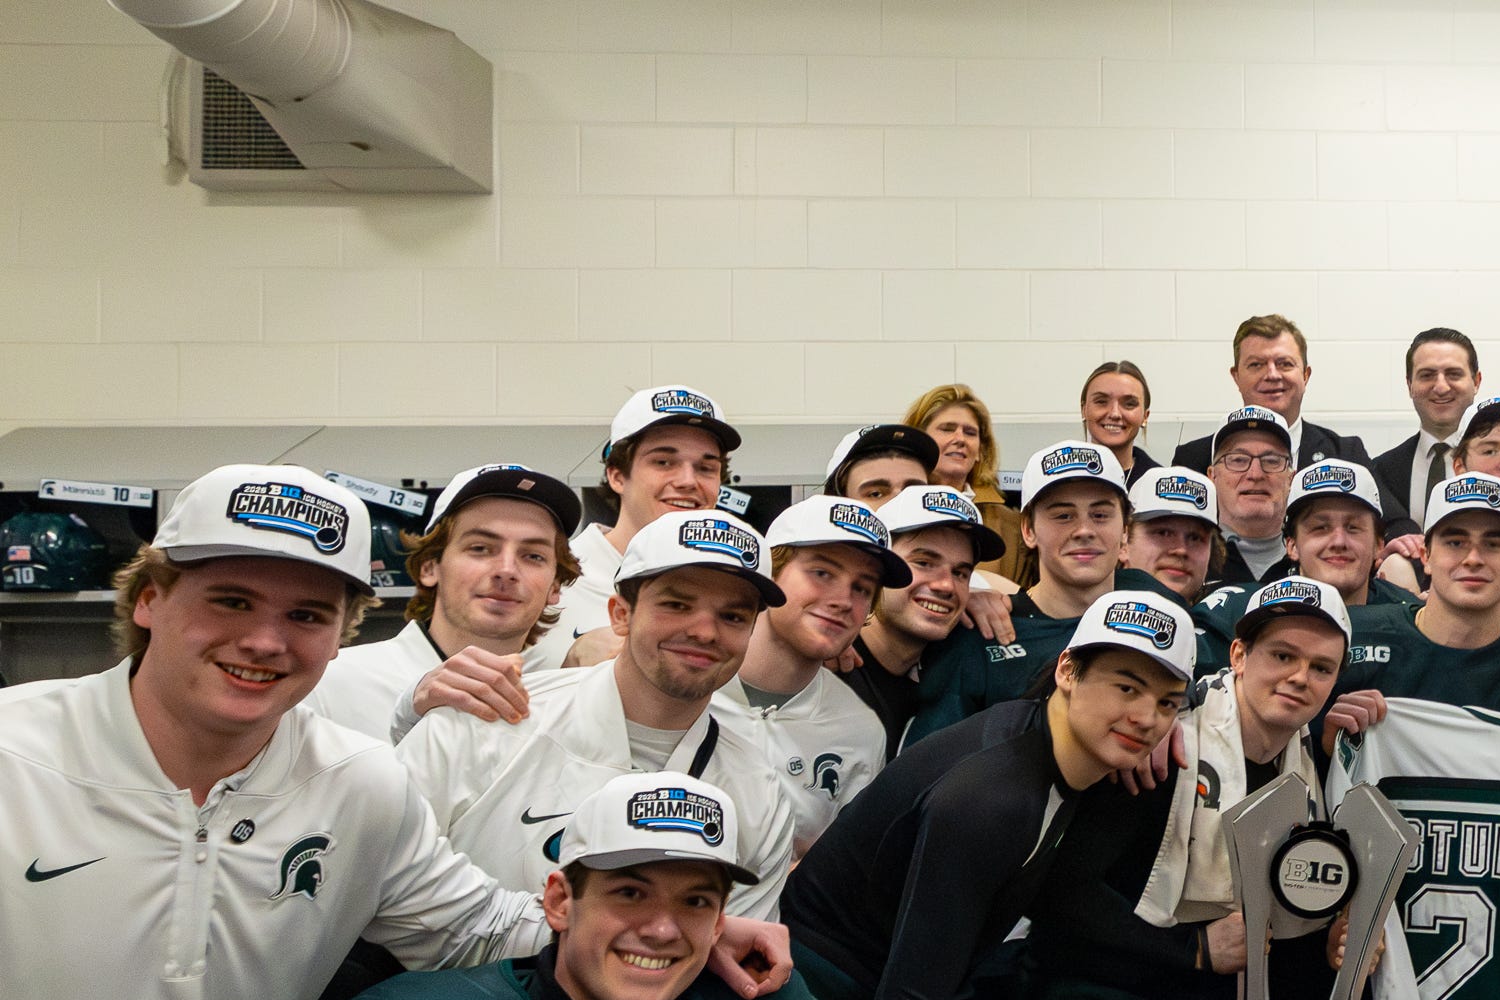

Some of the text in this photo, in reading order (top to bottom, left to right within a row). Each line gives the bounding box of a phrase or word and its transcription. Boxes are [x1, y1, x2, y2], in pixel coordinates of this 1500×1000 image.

[656, 396, 713, 412] CHAMPIONS
[1044, 452, 1098, 470] CHAMPIONS
[1003, 476, 1021, 485] Stra
[1305, 472, 1352, 487] CHAMPIONS
[113, 488, 130, 502] 10
[389, 490, 406, 506] 13
[1159, 482, 1206, 498] CHAMPIONS
[1447, 485, 1500, 498] CHAMPIONS
[236, 494, 344, 530] CHAMPIONS
[927, 497, 977, 519] CHAMPIONS
[834, 509, 888, 540] CHAMPIONS
[684, 528, 758, 555] CHAMPIONS
[13, 567, 35, 585] 10
[1262, 588, 1319, 602] CHAMPIONS
[1109, 609, 1174, 633] CHAMPIONS
[790, 761, 803, 772] DS
[633, 801, 722, 826] CHAMPIONS
